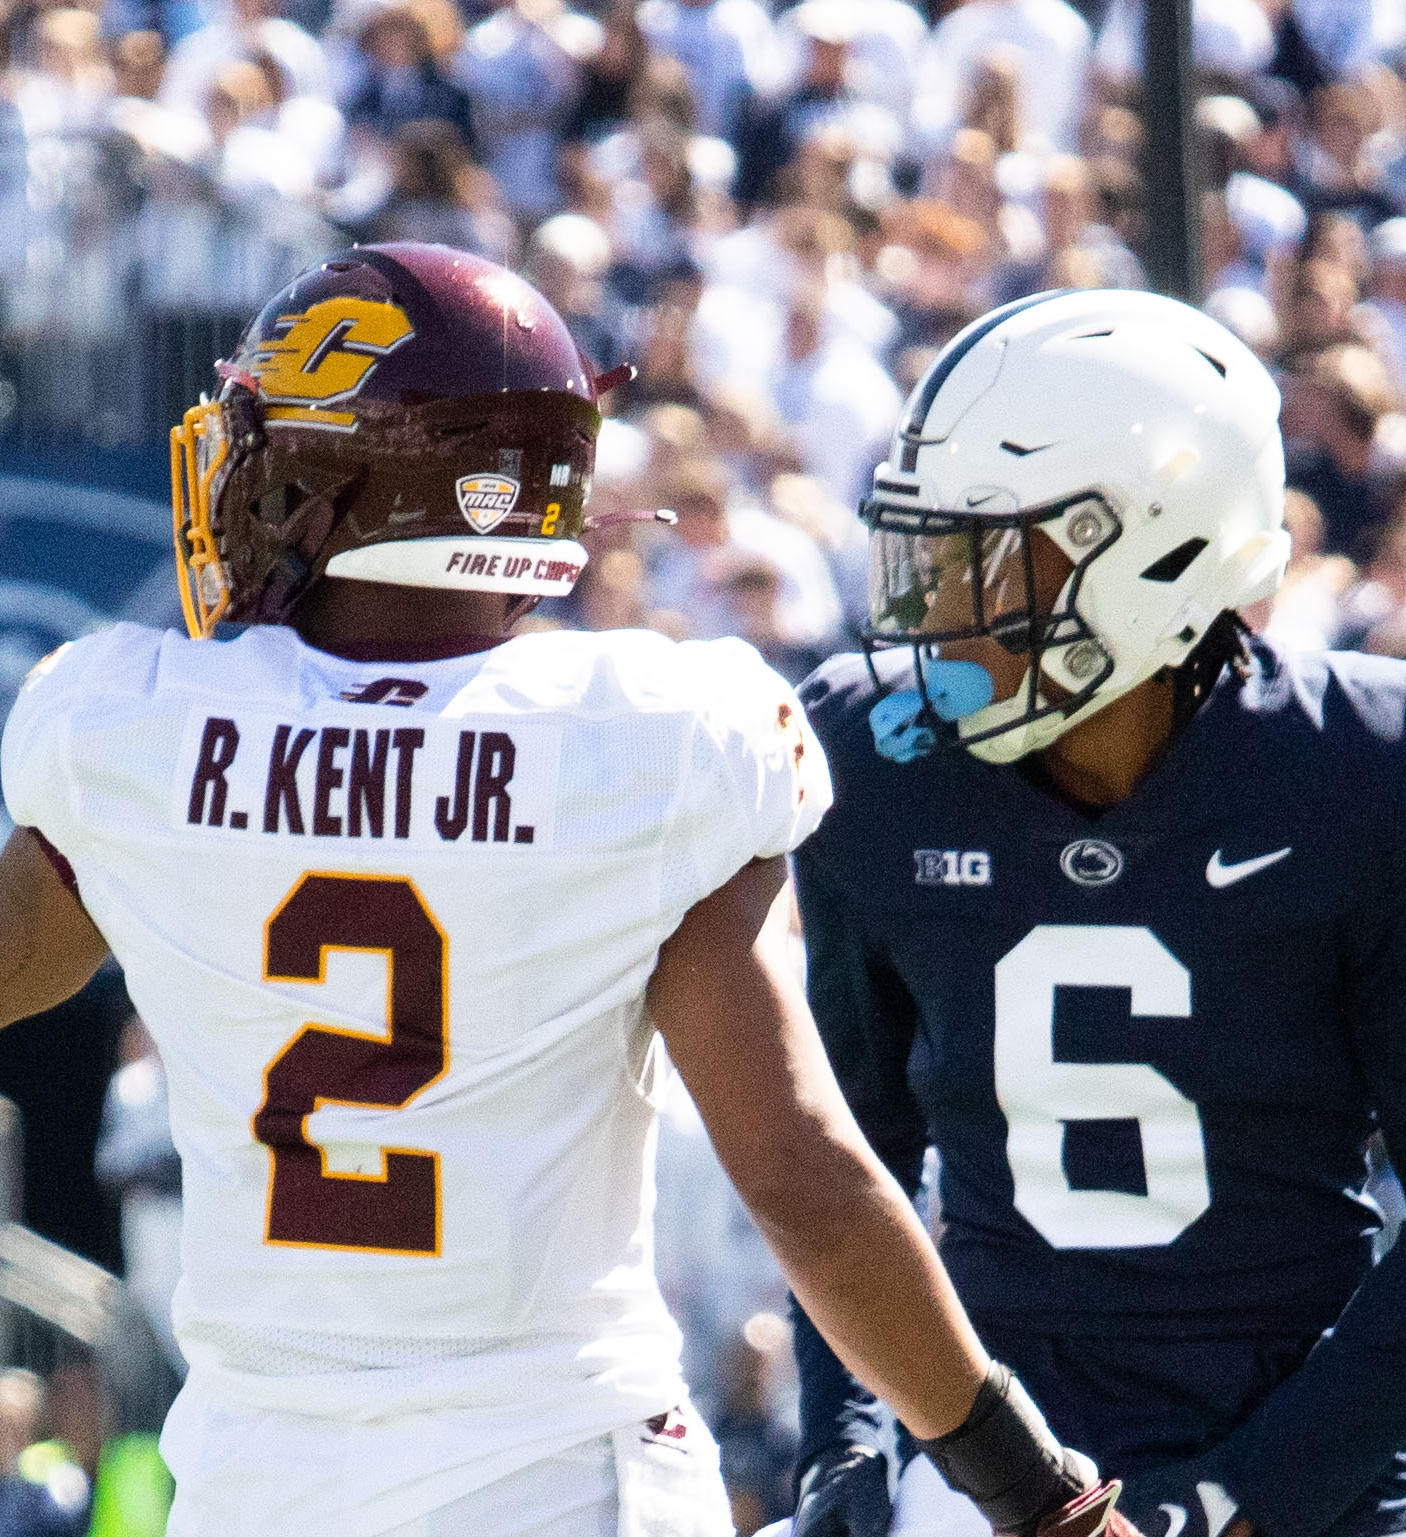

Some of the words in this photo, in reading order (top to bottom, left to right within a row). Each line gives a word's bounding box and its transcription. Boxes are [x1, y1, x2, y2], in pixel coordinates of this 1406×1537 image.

[461, 491, 513, 509] MAC
[541, 502, 561, 536] 2
[446, 552, 502, 577] FIRE
[503, 557, 532, 580] UP
[187, 717, 248, 830] R.
[263, 724, 425, 839] KENT
[434, 731, 535, 843] JR.
[250, 869, 450, 1257] 2
[994, 923, 1211, 1249] 6
